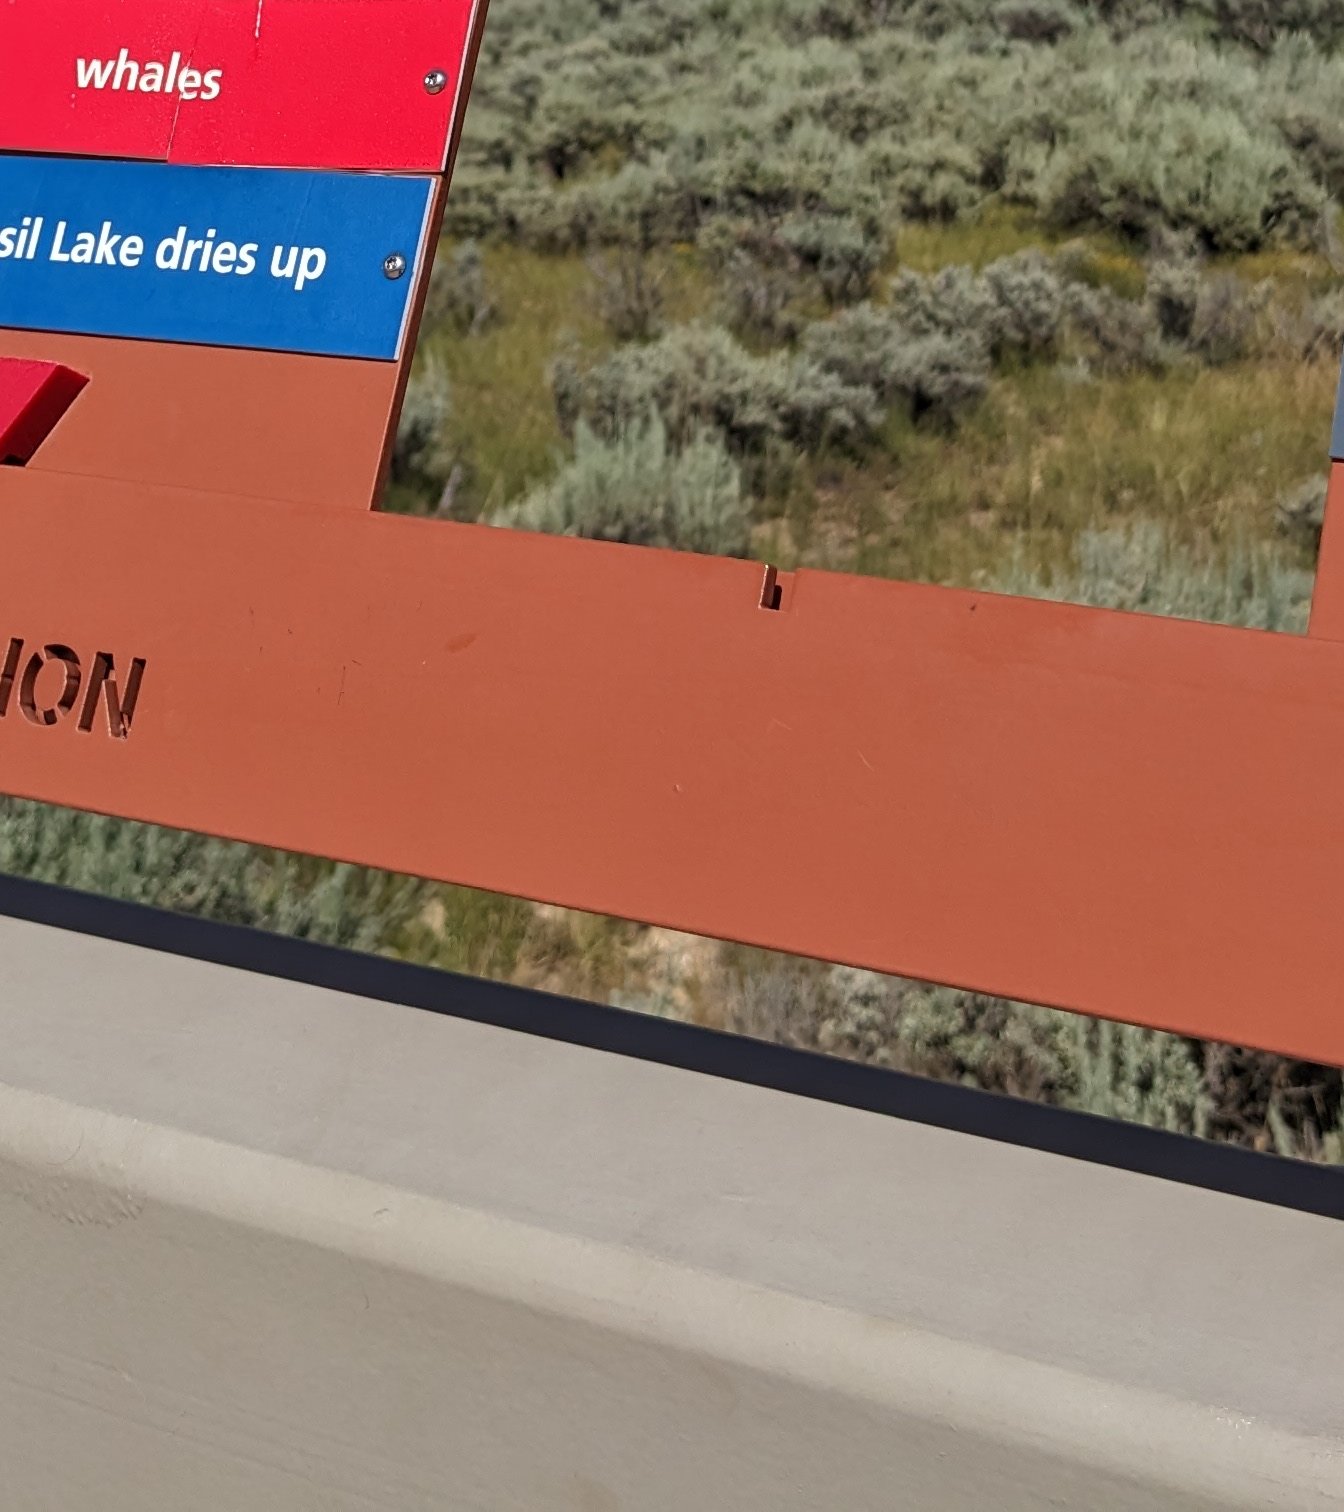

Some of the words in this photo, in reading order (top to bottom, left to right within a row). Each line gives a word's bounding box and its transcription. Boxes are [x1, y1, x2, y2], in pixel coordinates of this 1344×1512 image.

[77, 49, 222, 99] whales
[50, 222, 143, 266] Lake
[156, 227, 258, 274] dries
[271, 246, 326, 290] up
